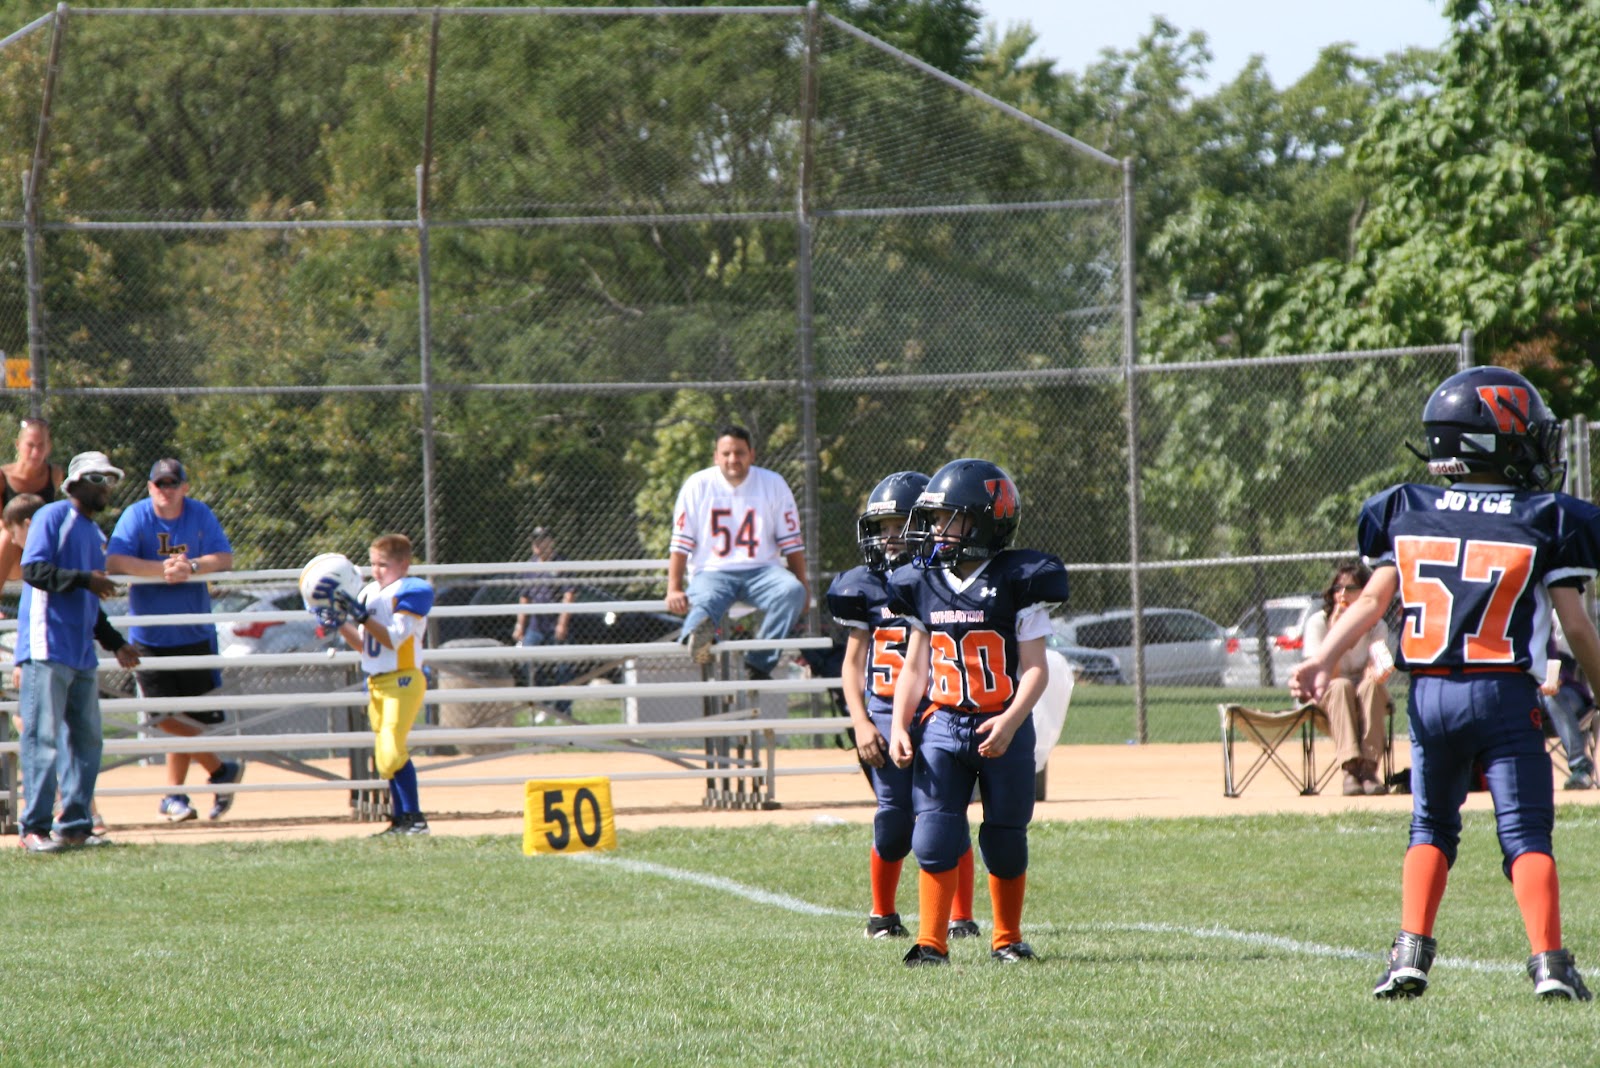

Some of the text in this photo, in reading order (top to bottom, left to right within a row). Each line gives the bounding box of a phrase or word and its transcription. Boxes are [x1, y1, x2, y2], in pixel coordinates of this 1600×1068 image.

[1476, 385, 1531, 434] W
[1430, 462, 1466, 474] ddell
[1435, 490, 1515, 514] JOYCE
[676, 511, 687, 532] 4
[711, 508, 759, 557] 54
[784, 511, 797, 532] 5
[1394, 535, 1537, 664] 57
[930, 609, 984, 624] WHEATON
[397, 676, 412, 688] W
[930, 630, 1014, 711] 60
[543, 787, 602, 851] 50
